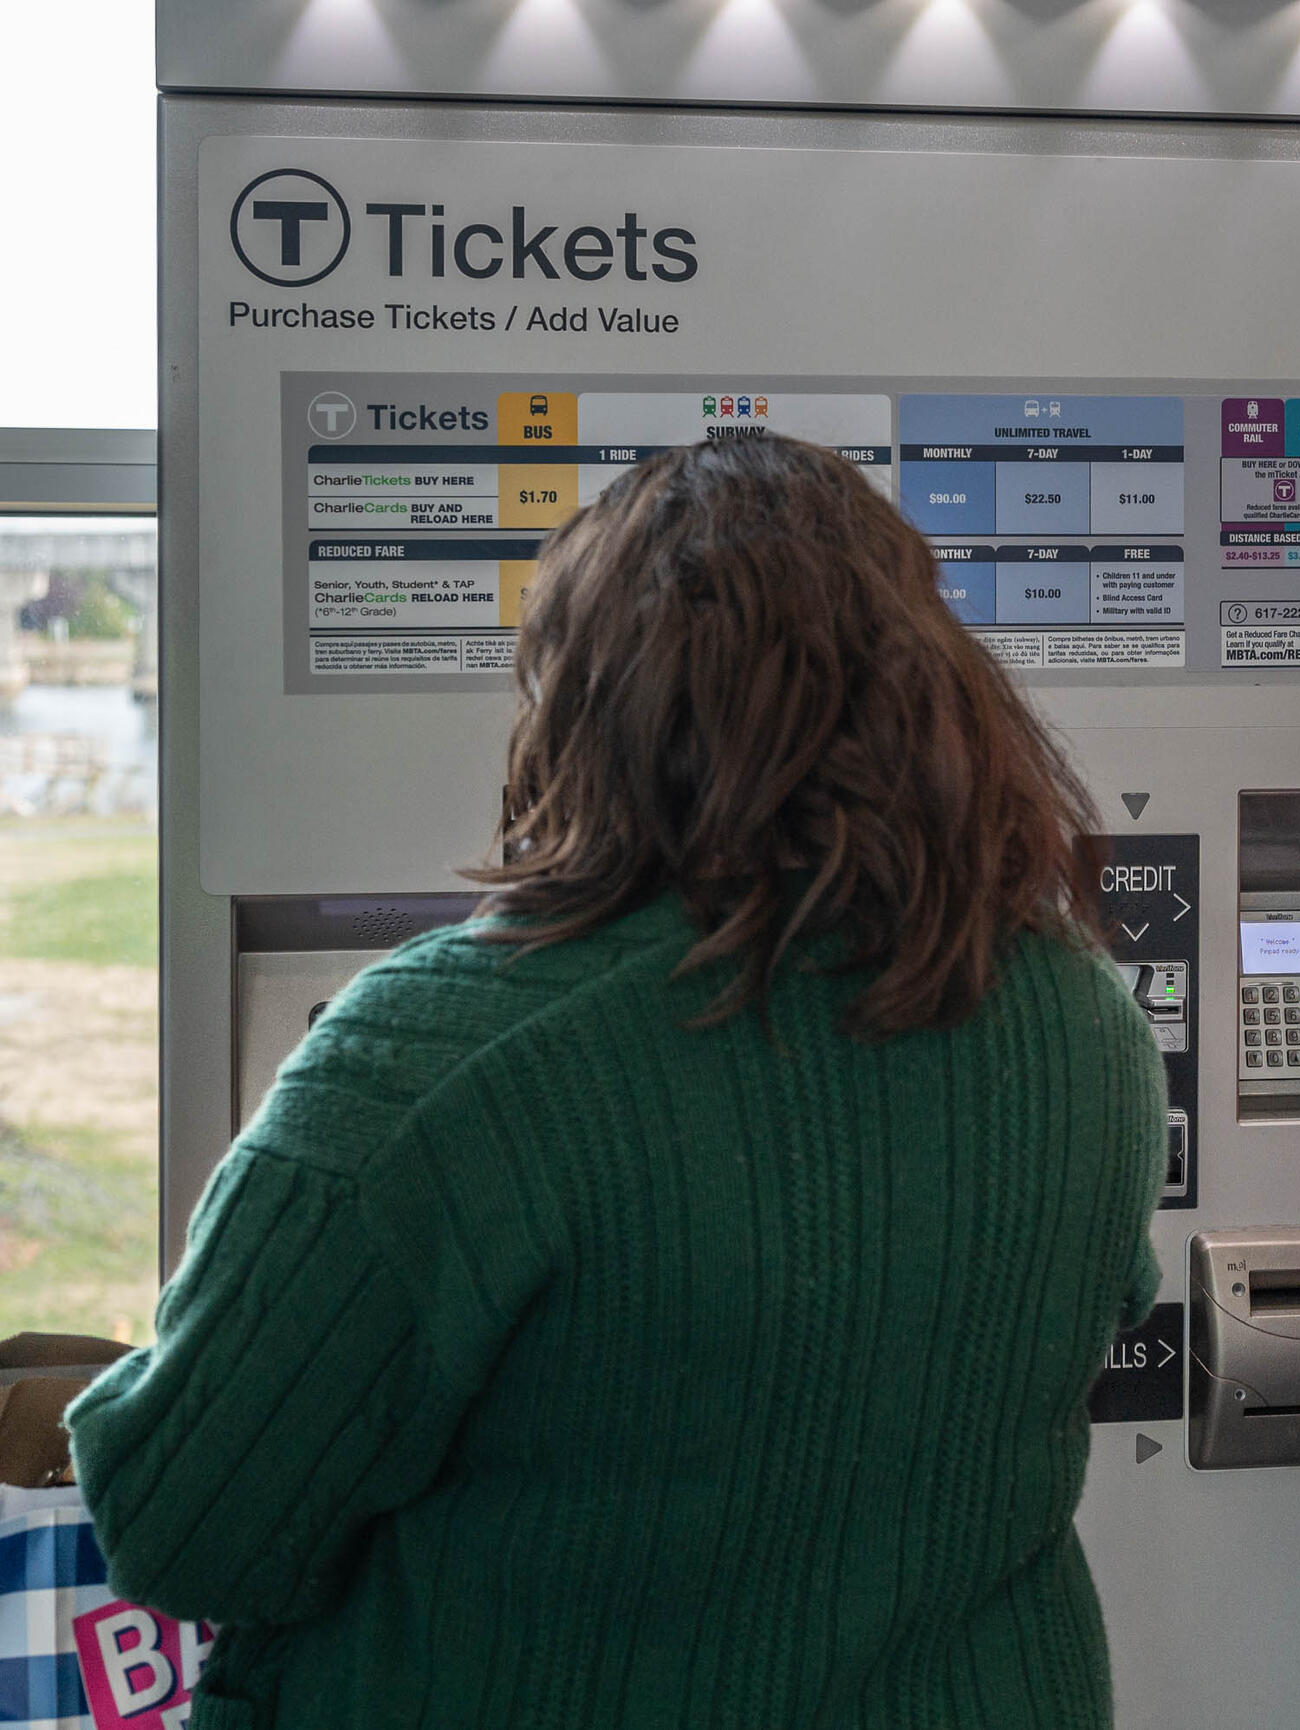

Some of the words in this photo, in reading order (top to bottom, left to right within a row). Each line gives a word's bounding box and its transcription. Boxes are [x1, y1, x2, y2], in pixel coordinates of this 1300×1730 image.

[366, 203, 699, 282] Tickets
[229, 301, 375, 330] Purchase
[385, 304, 496, 331] Tickets
[526, 306, 588, 332] Add
[598, 307, 680, 334] Value
[366, 404, 489, 431] Tickets
[523, 426, 553, 439] BUS
[706, 426, 766, 440] SUBWAY
[994, 428, 1050, 438] UNLIMITED
[1052, 428, 1092, 438] TRAVEL
[1228, 423, 1278, 433] COMMUTER
[1243, 434, 1263, 443] RAIL
[599, 450, 606, 461] 1
[609, 450, 637, 461] RIDE
[923, 448, 972, 459] MONTHLY
[1027, 449, 1059, 459] 7-DAY
[1121, 449, 1153, 459] 1-DAY
[1241, 461, 1256, 469] BUY
[1258, 461, 1278, 469] HERE
[313, 475, 411, 486] CharlieTickets
[415, 476, 439, 486] BUY
[442, 476, 475, 486] HERE
[1254, 471, 1266, 479] the
[1267, 471, 1298, 479] mTicket
[519, 490, 558, 504] $1.70
[929, 493, 967, 505] $90.00
[1024, 493, 1062, 505] $22.50
[1118, 493, 1156, 505] $11.00
[313, 502, 408, 514] CharlieCards
[411, 504, 435, 513] BUY
[438, 504, 463, 513] AND
[410, 515, 458, 524] RELOAD
[461, 515, 493, 524] HERE
[1229, 533, 1272, 543] DISTANCE
[318, 545, 372, 557] REDUCED
[374, 545, 405, 557] FARE
[933, 548, 973, 559] ONTHLY
[1027, 549, 1059, 559] 7-DAY
[1124, 549, 1151, 559] FREE
[1102, 571, 1130, 580] Children
[1131, 571, 1141, 580] 11
[1141, 571, 1155, 580] and
[1155, 571, 1176, 580] under
[313, 580, 352, 591] Senior,
[354, 580, 389, 590] Youth,
[441, 580, 451, 589] &
[453, 580, 476, 589] TAP
[1102, 580, 1118, 589] with
[1119, 581, 1142, 591] paying
[314, 592, 408, 604] CharlieCards
[411, 593, 459, 602] RELOAD
[462, 593, 495, 602] HERE
[1024, 588, 1062, 600] $10.00
[1102, 593, 1120, 602] Blind
[1121, 593, 1145, 602] Access
[1146, 593, 1163, 602] Card
[360, 607, 397, 618] Grade)
[1102, 606, 1128, 616] Military
[1129, 606, 1145, 615] with
[1145, 606, 1163, 615] valid
[1226, 631, 1239, 639] Get
[1244, 631, 1273, 639] Reduced
[1273, 631, 1288, 639] Fare
[1226, 640, 1245, 648] Learn
[1251, 642, 1264, 650] you
[1264, 640, 1286, 650] qualify
[1286, 640, 1294, 648] at
[1100, 865, 1177, 892] CREDIT
[1104, 1342, 1147, 1369] ILLS
